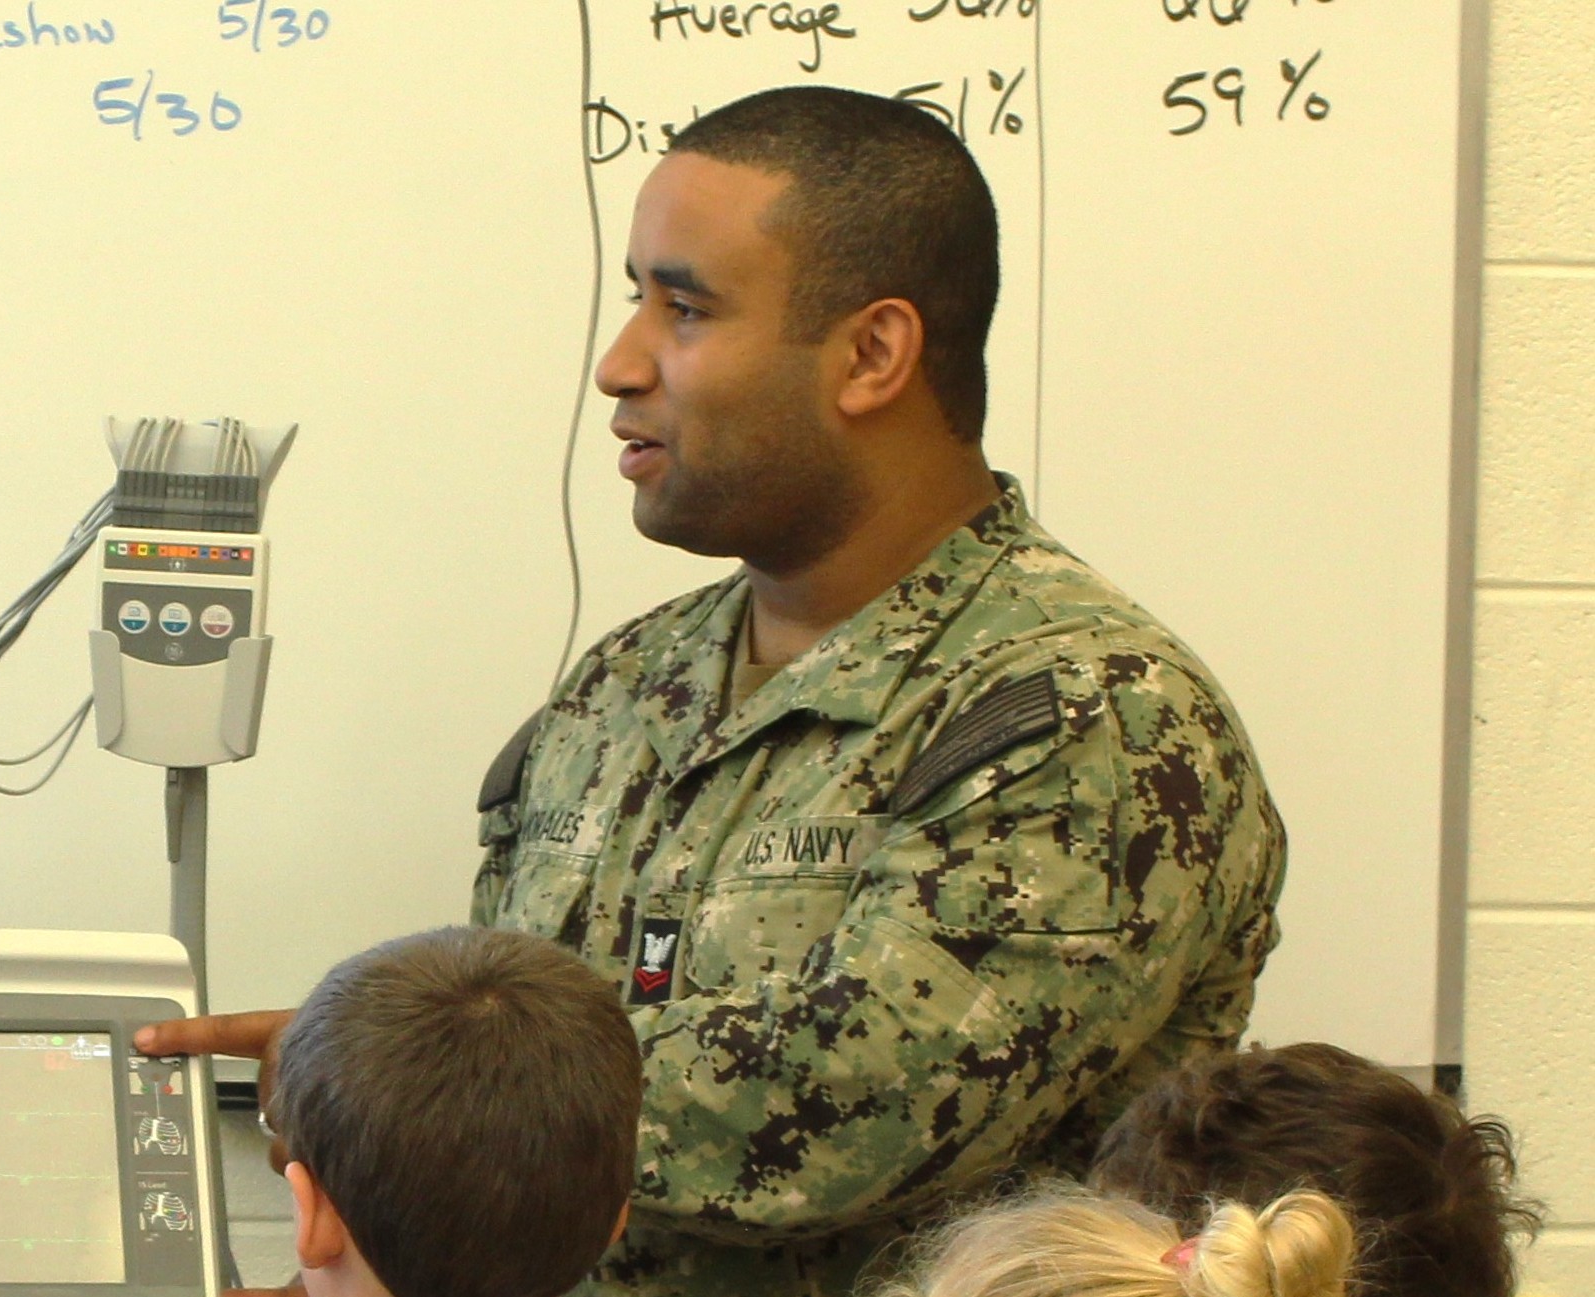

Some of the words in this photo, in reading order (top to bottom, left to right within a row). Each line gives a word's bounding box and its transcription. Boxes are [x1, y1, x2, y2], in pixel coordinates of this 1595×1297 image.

[218, 0, 330, 52] 5/30
[92, 70, 242, 141] 5/30
[745, 831, 774, 865] U.S.
[783, 827, 855, 864] NAVY
